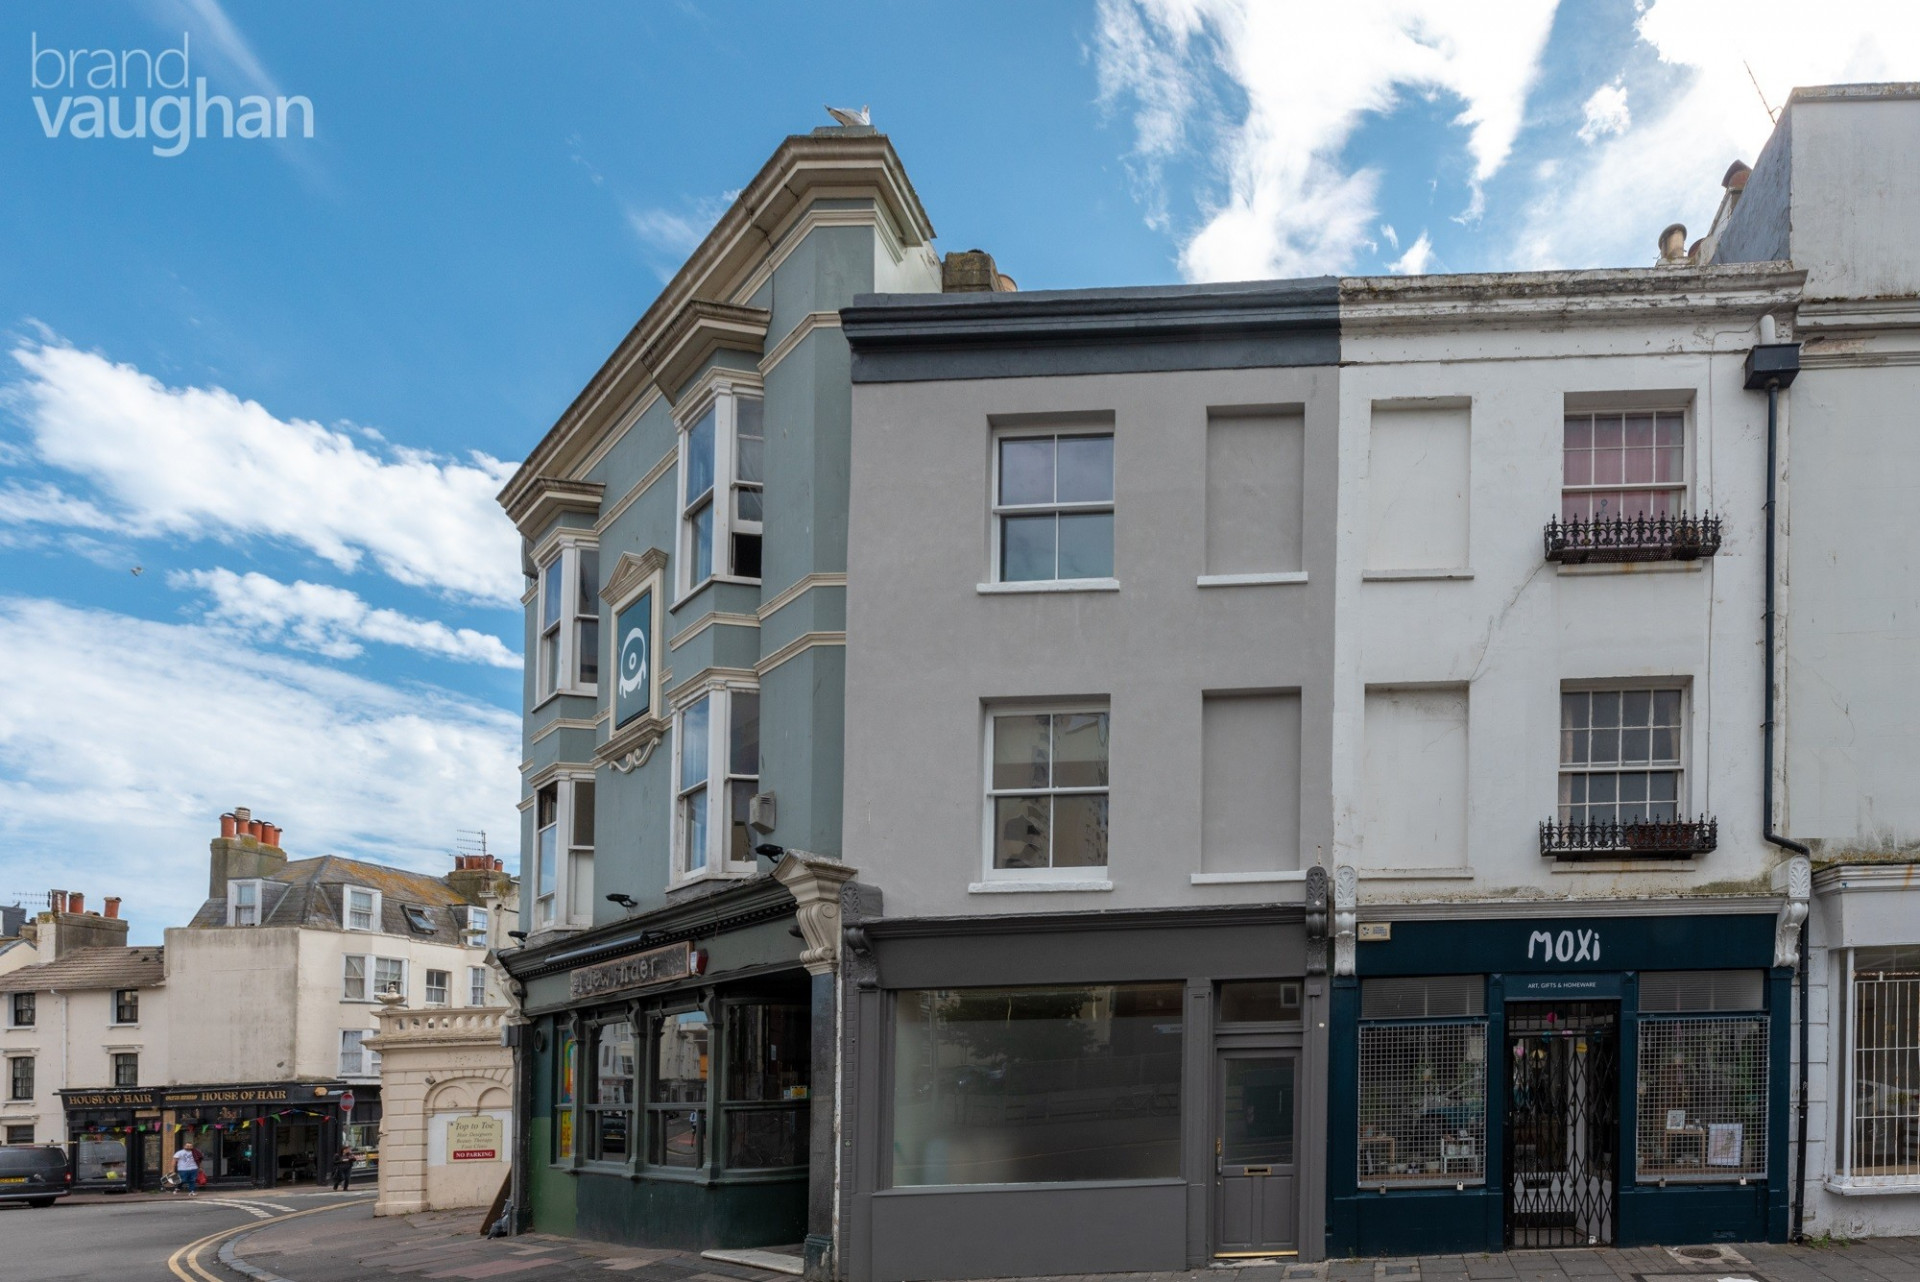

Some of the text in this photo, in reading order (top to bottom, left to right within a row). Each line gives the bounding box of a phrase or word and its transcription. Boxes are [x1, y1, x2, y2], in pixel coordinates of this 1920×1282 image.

[69, 1094, 152, 1105] HOUSE OF HAIR
[202, 1092, 239, 1101] HOUSE
[240, 1090, 256, 1100] OF
[257, 1090, 287, 1100] HAIR
[456, 1122, 470, 1131] Top
[481, 1121, 494, 1129] Toe
